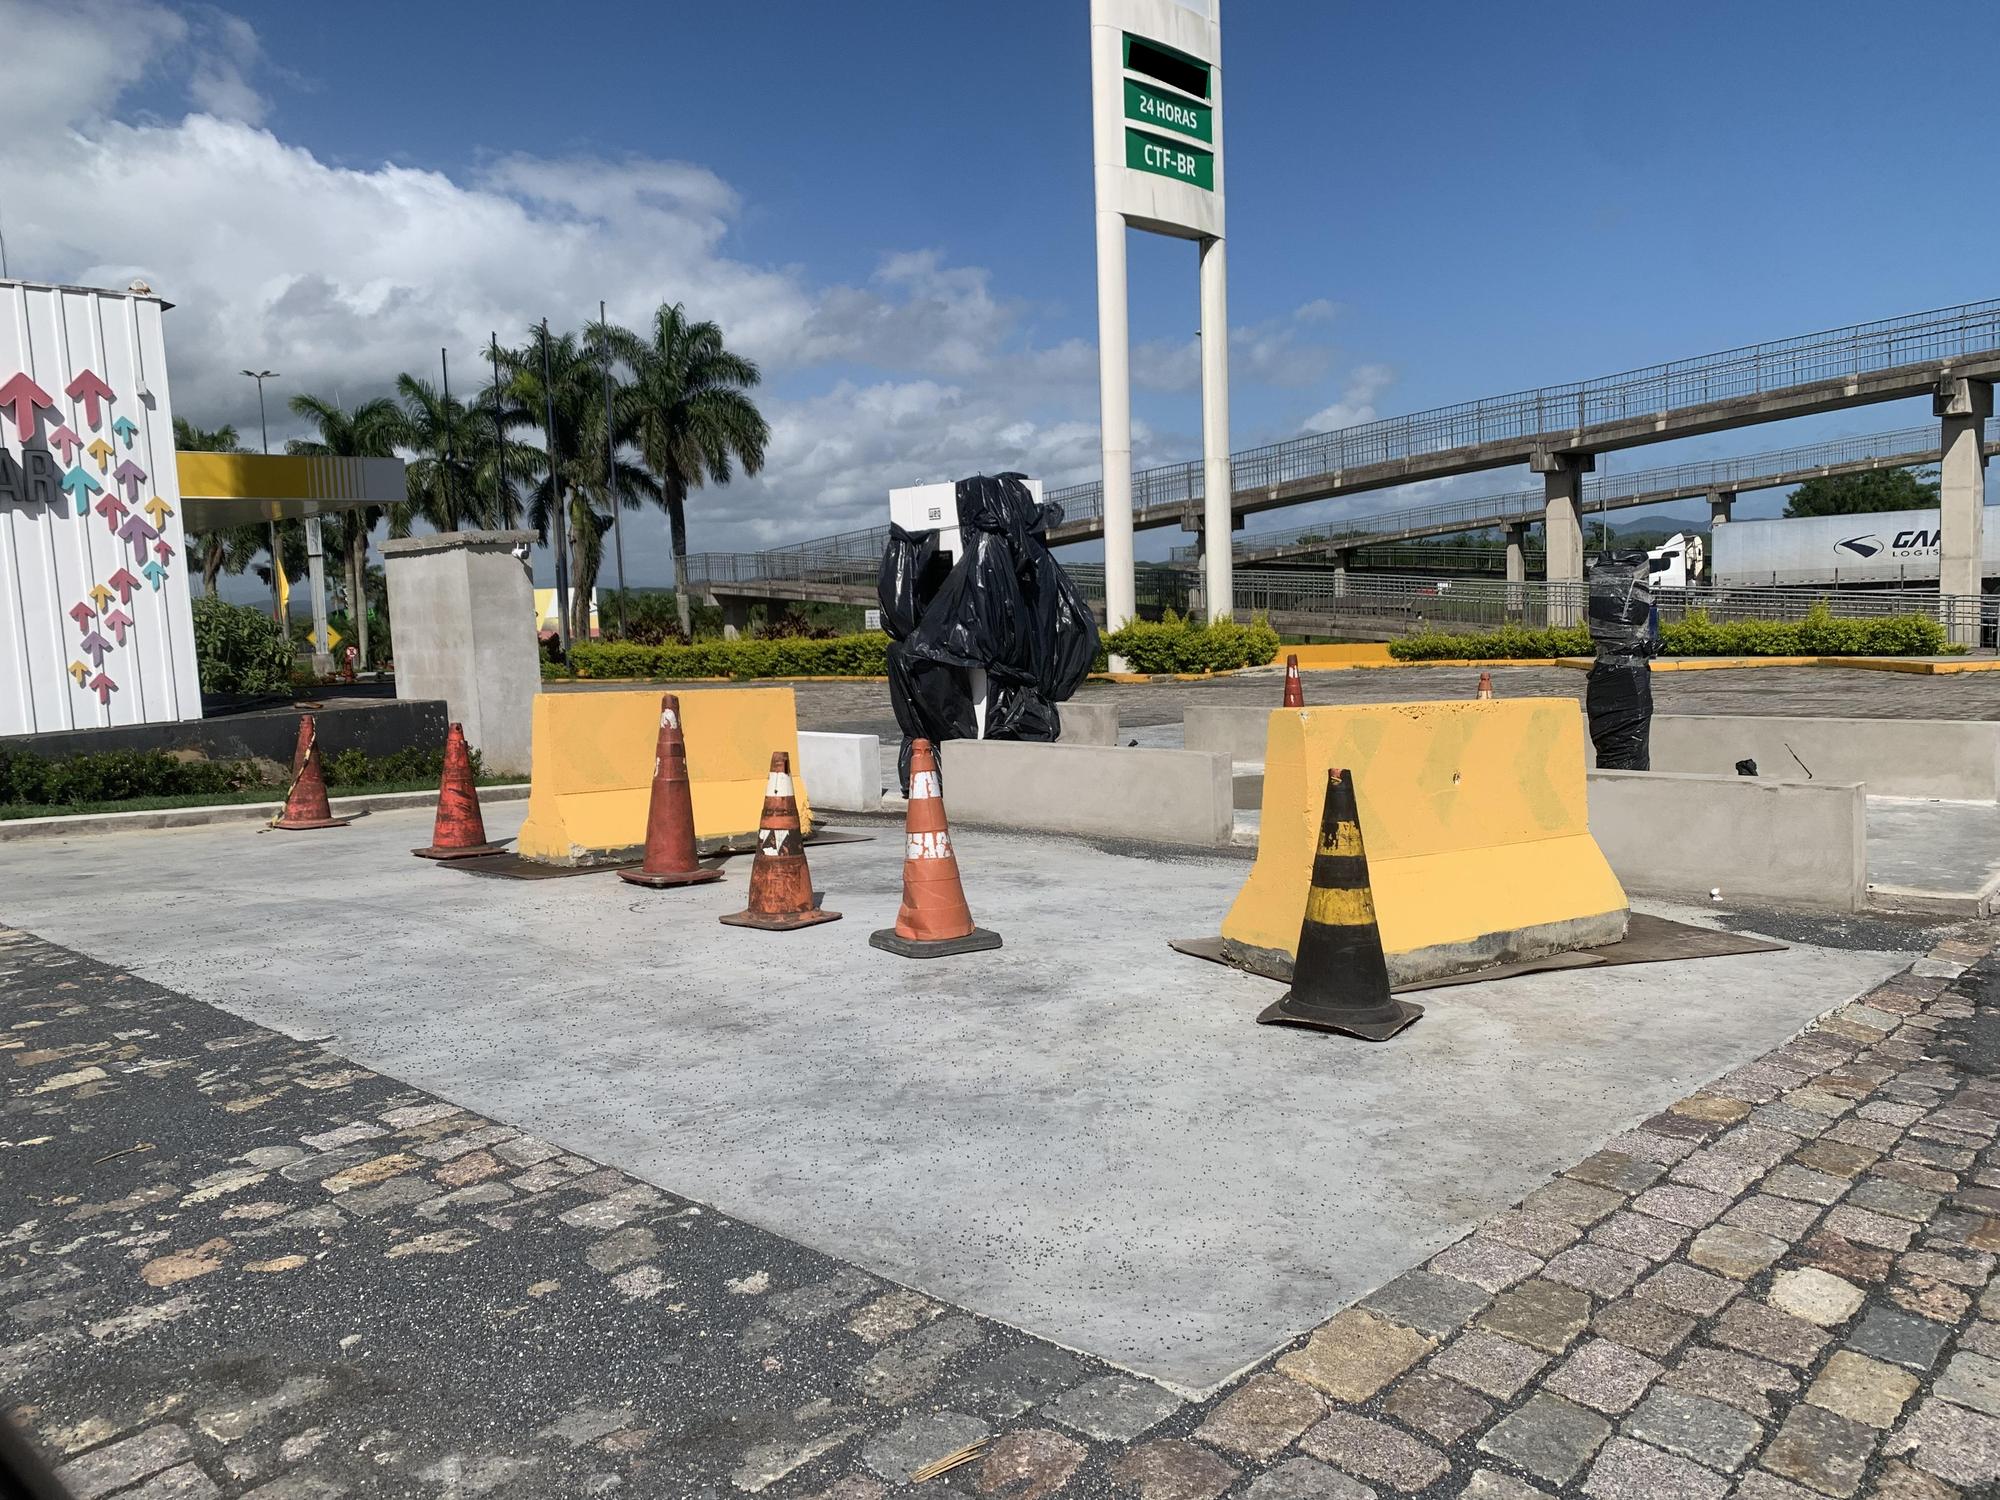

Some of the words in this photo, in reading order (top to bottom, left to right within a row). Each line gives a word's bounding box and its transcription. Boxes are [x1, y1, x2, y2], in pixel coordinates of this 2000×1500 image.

[1140, 95, 1154, 115] 24
[1156, 100, 1197, 129] HORAS
[1144, 144, 1196, 177] CTF-BR
